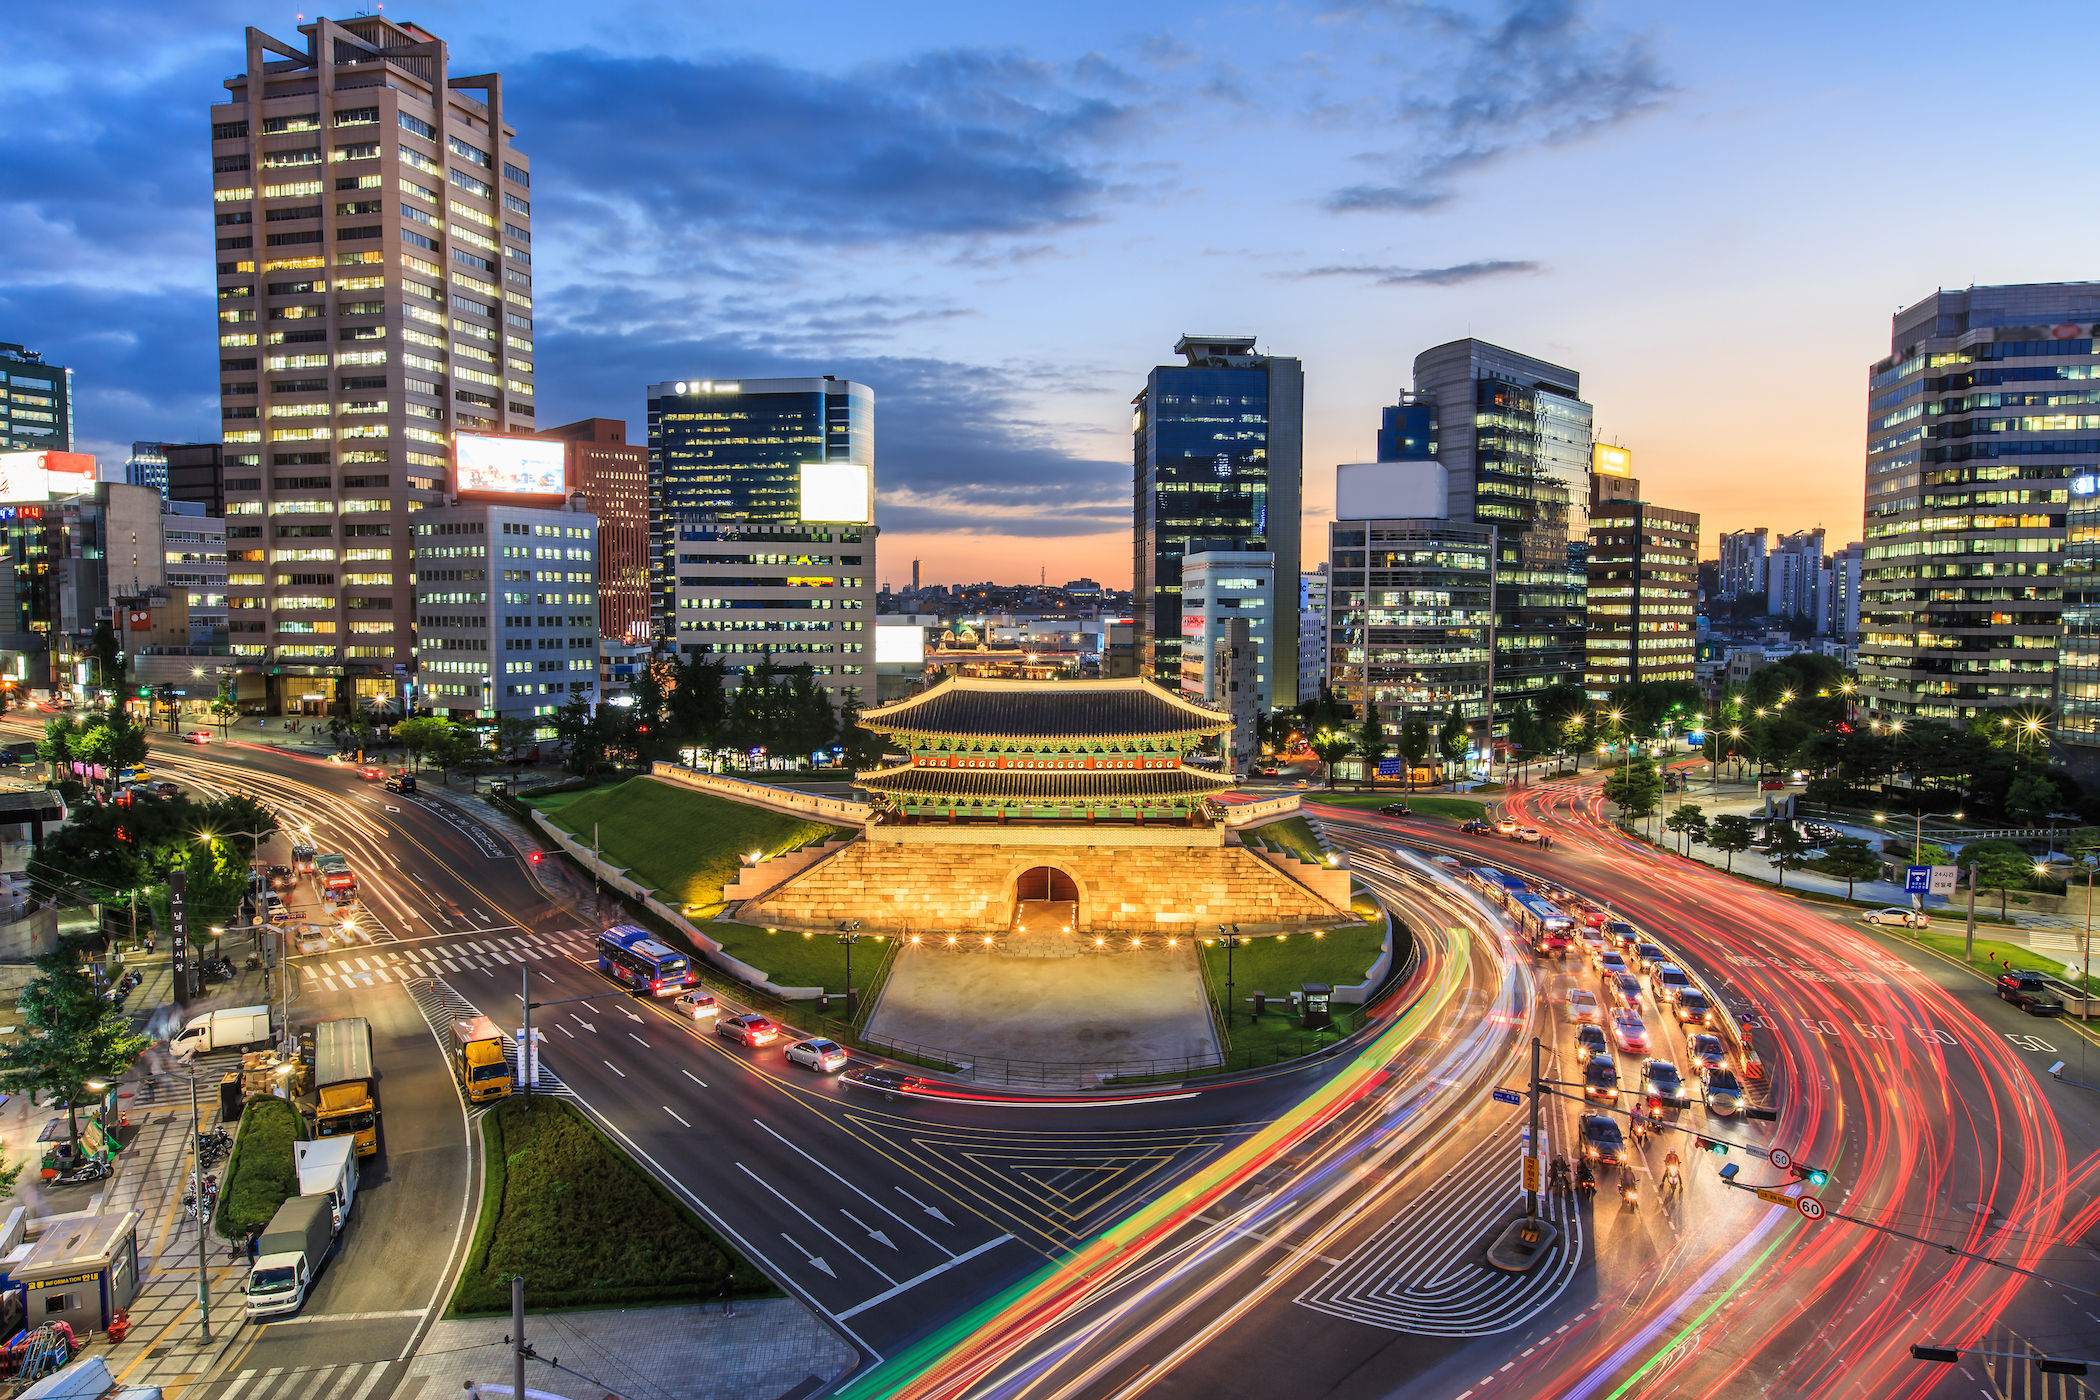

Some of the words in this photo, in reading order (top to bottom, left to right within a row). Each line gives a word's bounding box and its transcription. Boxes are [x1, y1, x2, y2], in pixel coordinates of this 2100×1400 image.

[173, 912, 184, 971] 남대문시장
[1800, 1018, 1841, 1036] 50
[1853, 1022, 1896, 1040] 50
[1912, 1028, 1959, 1045] 50
[2003, 1033, 2058, 1053] 50
[1775, 1154, 1787, 1165] 50
[1802, 1201, 1819, 1215] 60
[82, 1273, 98, 1282] 안내
